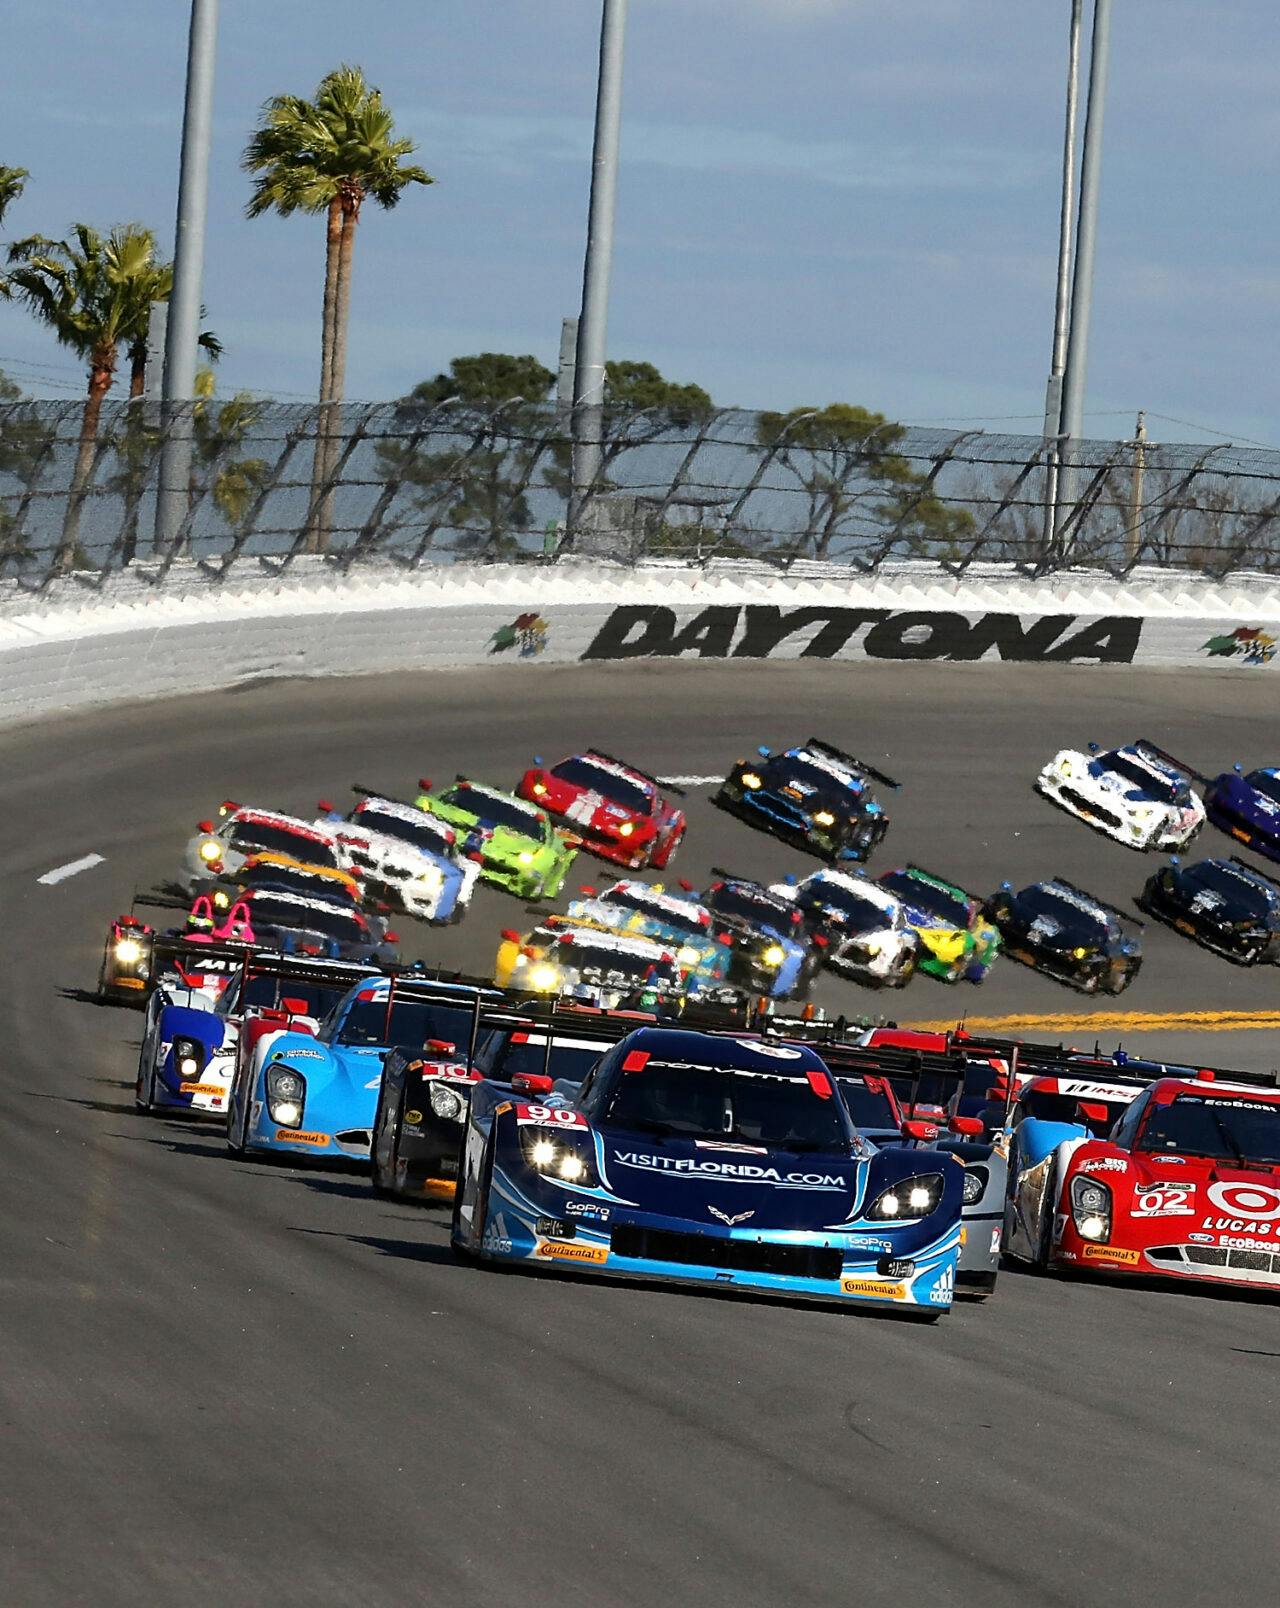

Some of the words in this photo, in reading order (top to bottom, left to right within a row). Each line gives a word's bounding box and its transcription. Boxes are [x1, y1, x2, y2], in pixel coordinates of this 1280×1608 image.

[578, 604, 1144, 664] DAYTONA
[1204, 1099, 1278, 1113] EcoBoost
[527, 1105, 577, 1123] 90
[277, 1130, 319, 1142] Continental
[614, 1150, 846, 1186] VISITFLORIDA.COM
[565, 1201, 610, 1216] GoPro
[1139, 1191, 1188, 1212] 02
[1202, 1216, 1272, 1235] LUCAS
[482, 1237, 512, 1253] adidas
[848, 1235, 893, 1248] GoPro
[541, 1245, 595, 1259] Continental
[1085, 1246, 1129, 1260] Continental
[844, 1280, 896, 1295] Continental
